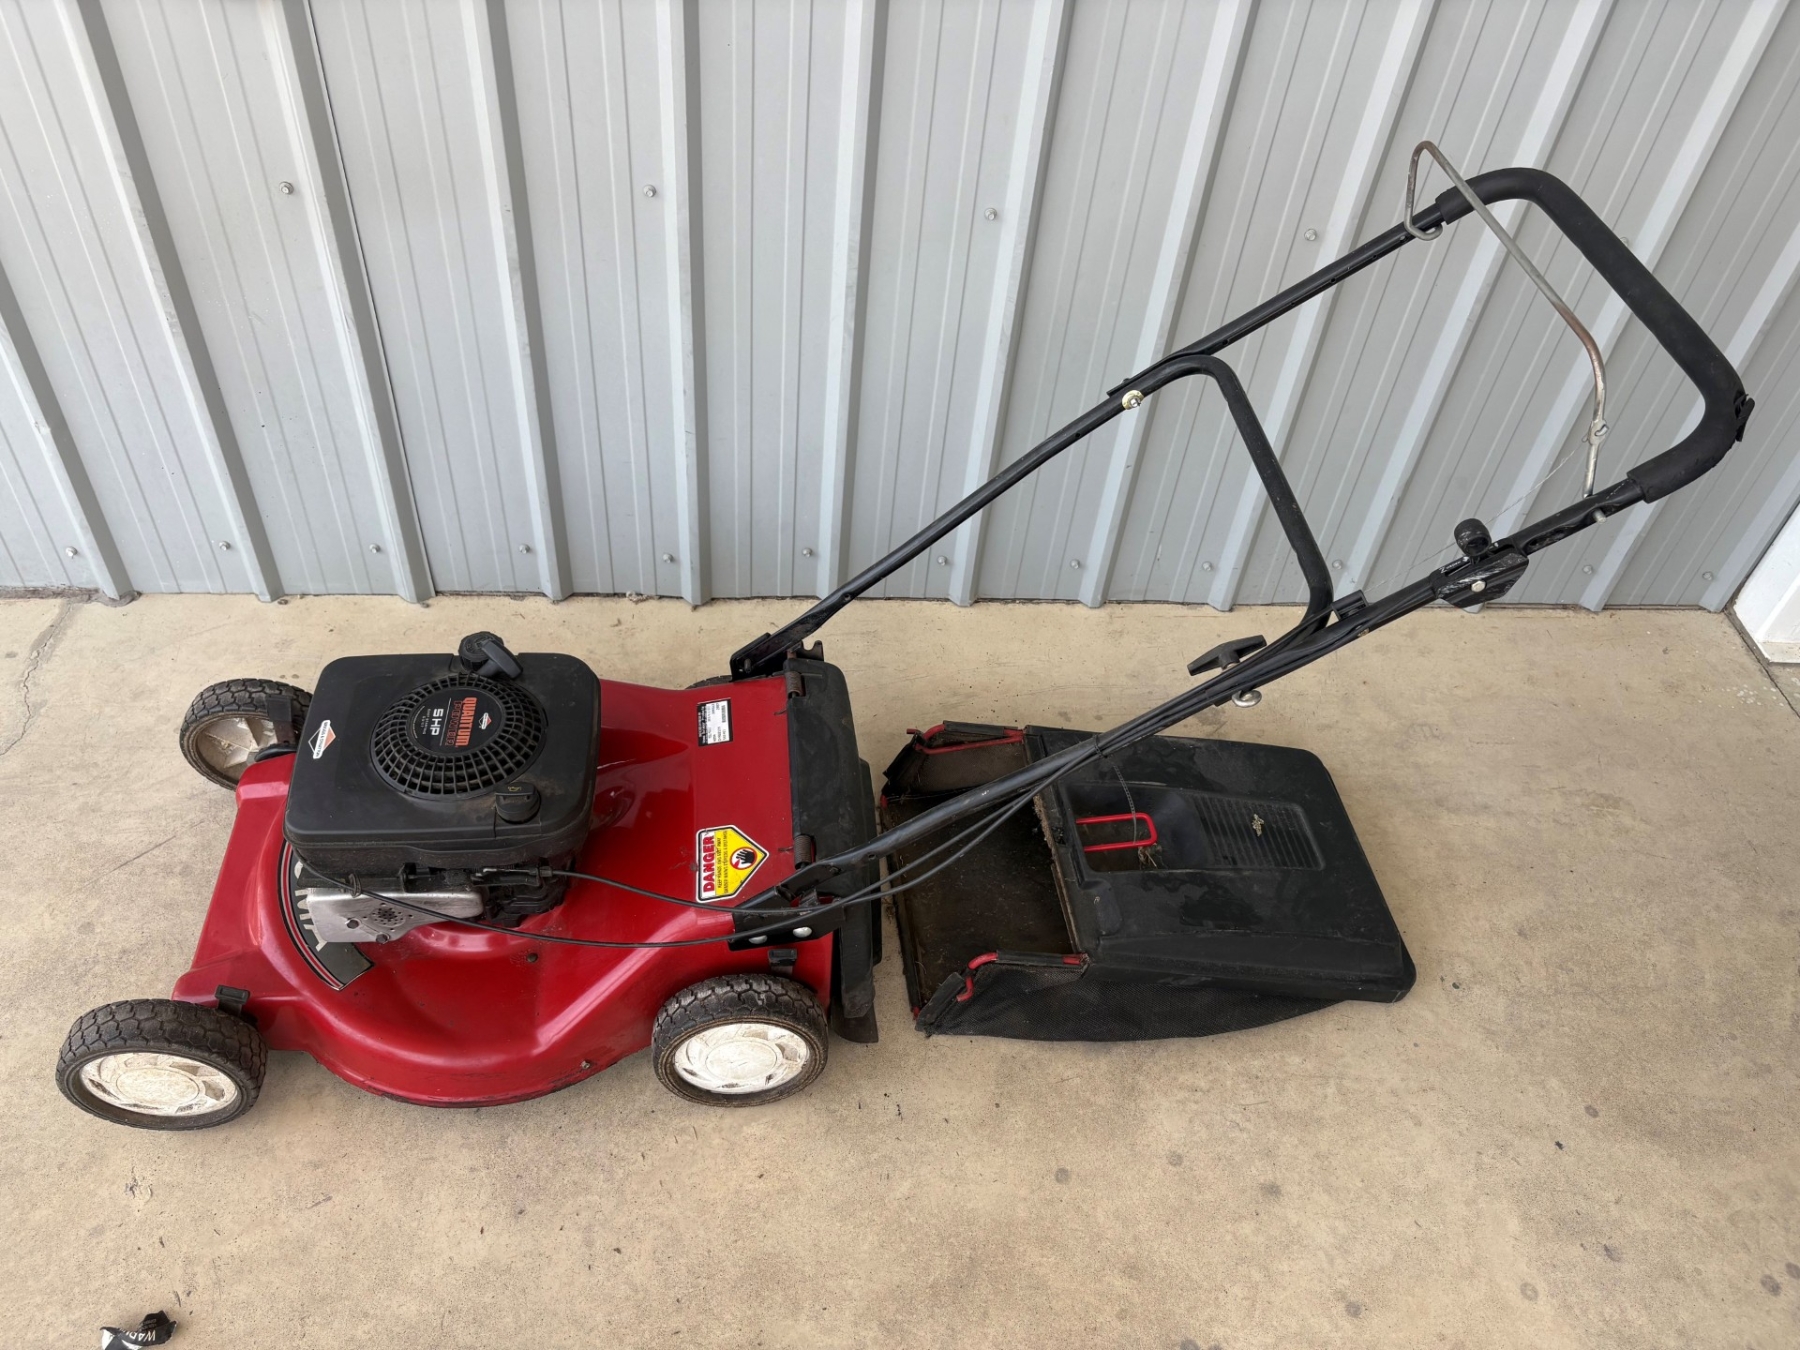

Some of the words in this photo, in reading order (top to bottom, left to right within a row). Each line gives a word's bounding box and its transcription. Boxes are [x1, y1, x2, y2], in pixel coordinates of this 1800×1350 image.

[445, 700, 463, 746] POWER
[455, 697, 477, 747] QUANTUM
[702, 835, 715, 893] DANGER
